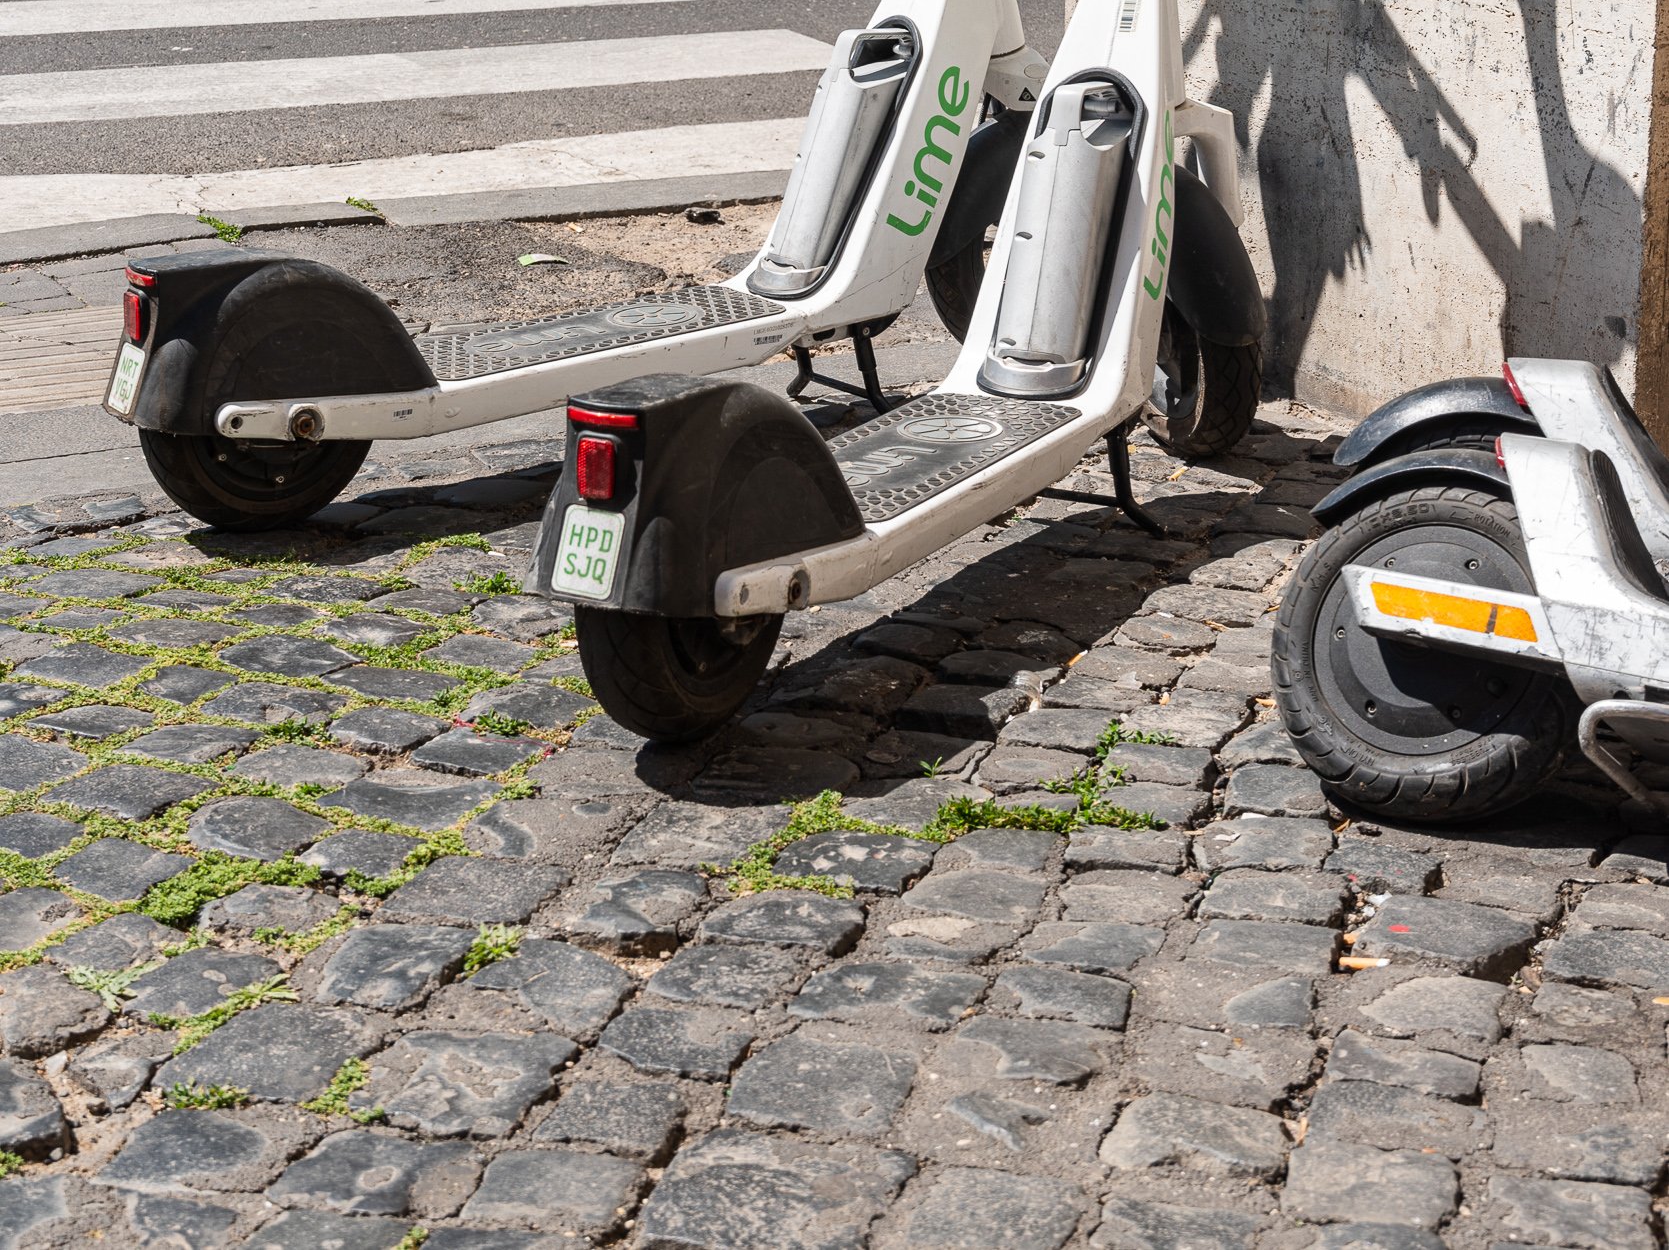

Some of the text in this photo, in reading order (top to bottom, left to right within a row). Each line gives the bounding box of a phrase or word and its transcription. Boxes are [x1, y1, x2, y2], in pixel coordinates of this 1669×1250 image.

[886, 65, 970, 237] Lime
[1143, 110, 1173, 301] Lime
[120, 356, 139, 378] NRT
[115, 378, 133, 400] VGJ
[569, 524, 614, 553] HPD
[1474, 513, 1511, 538] ROTATION
[564, 553, 607, 585] SJQ
